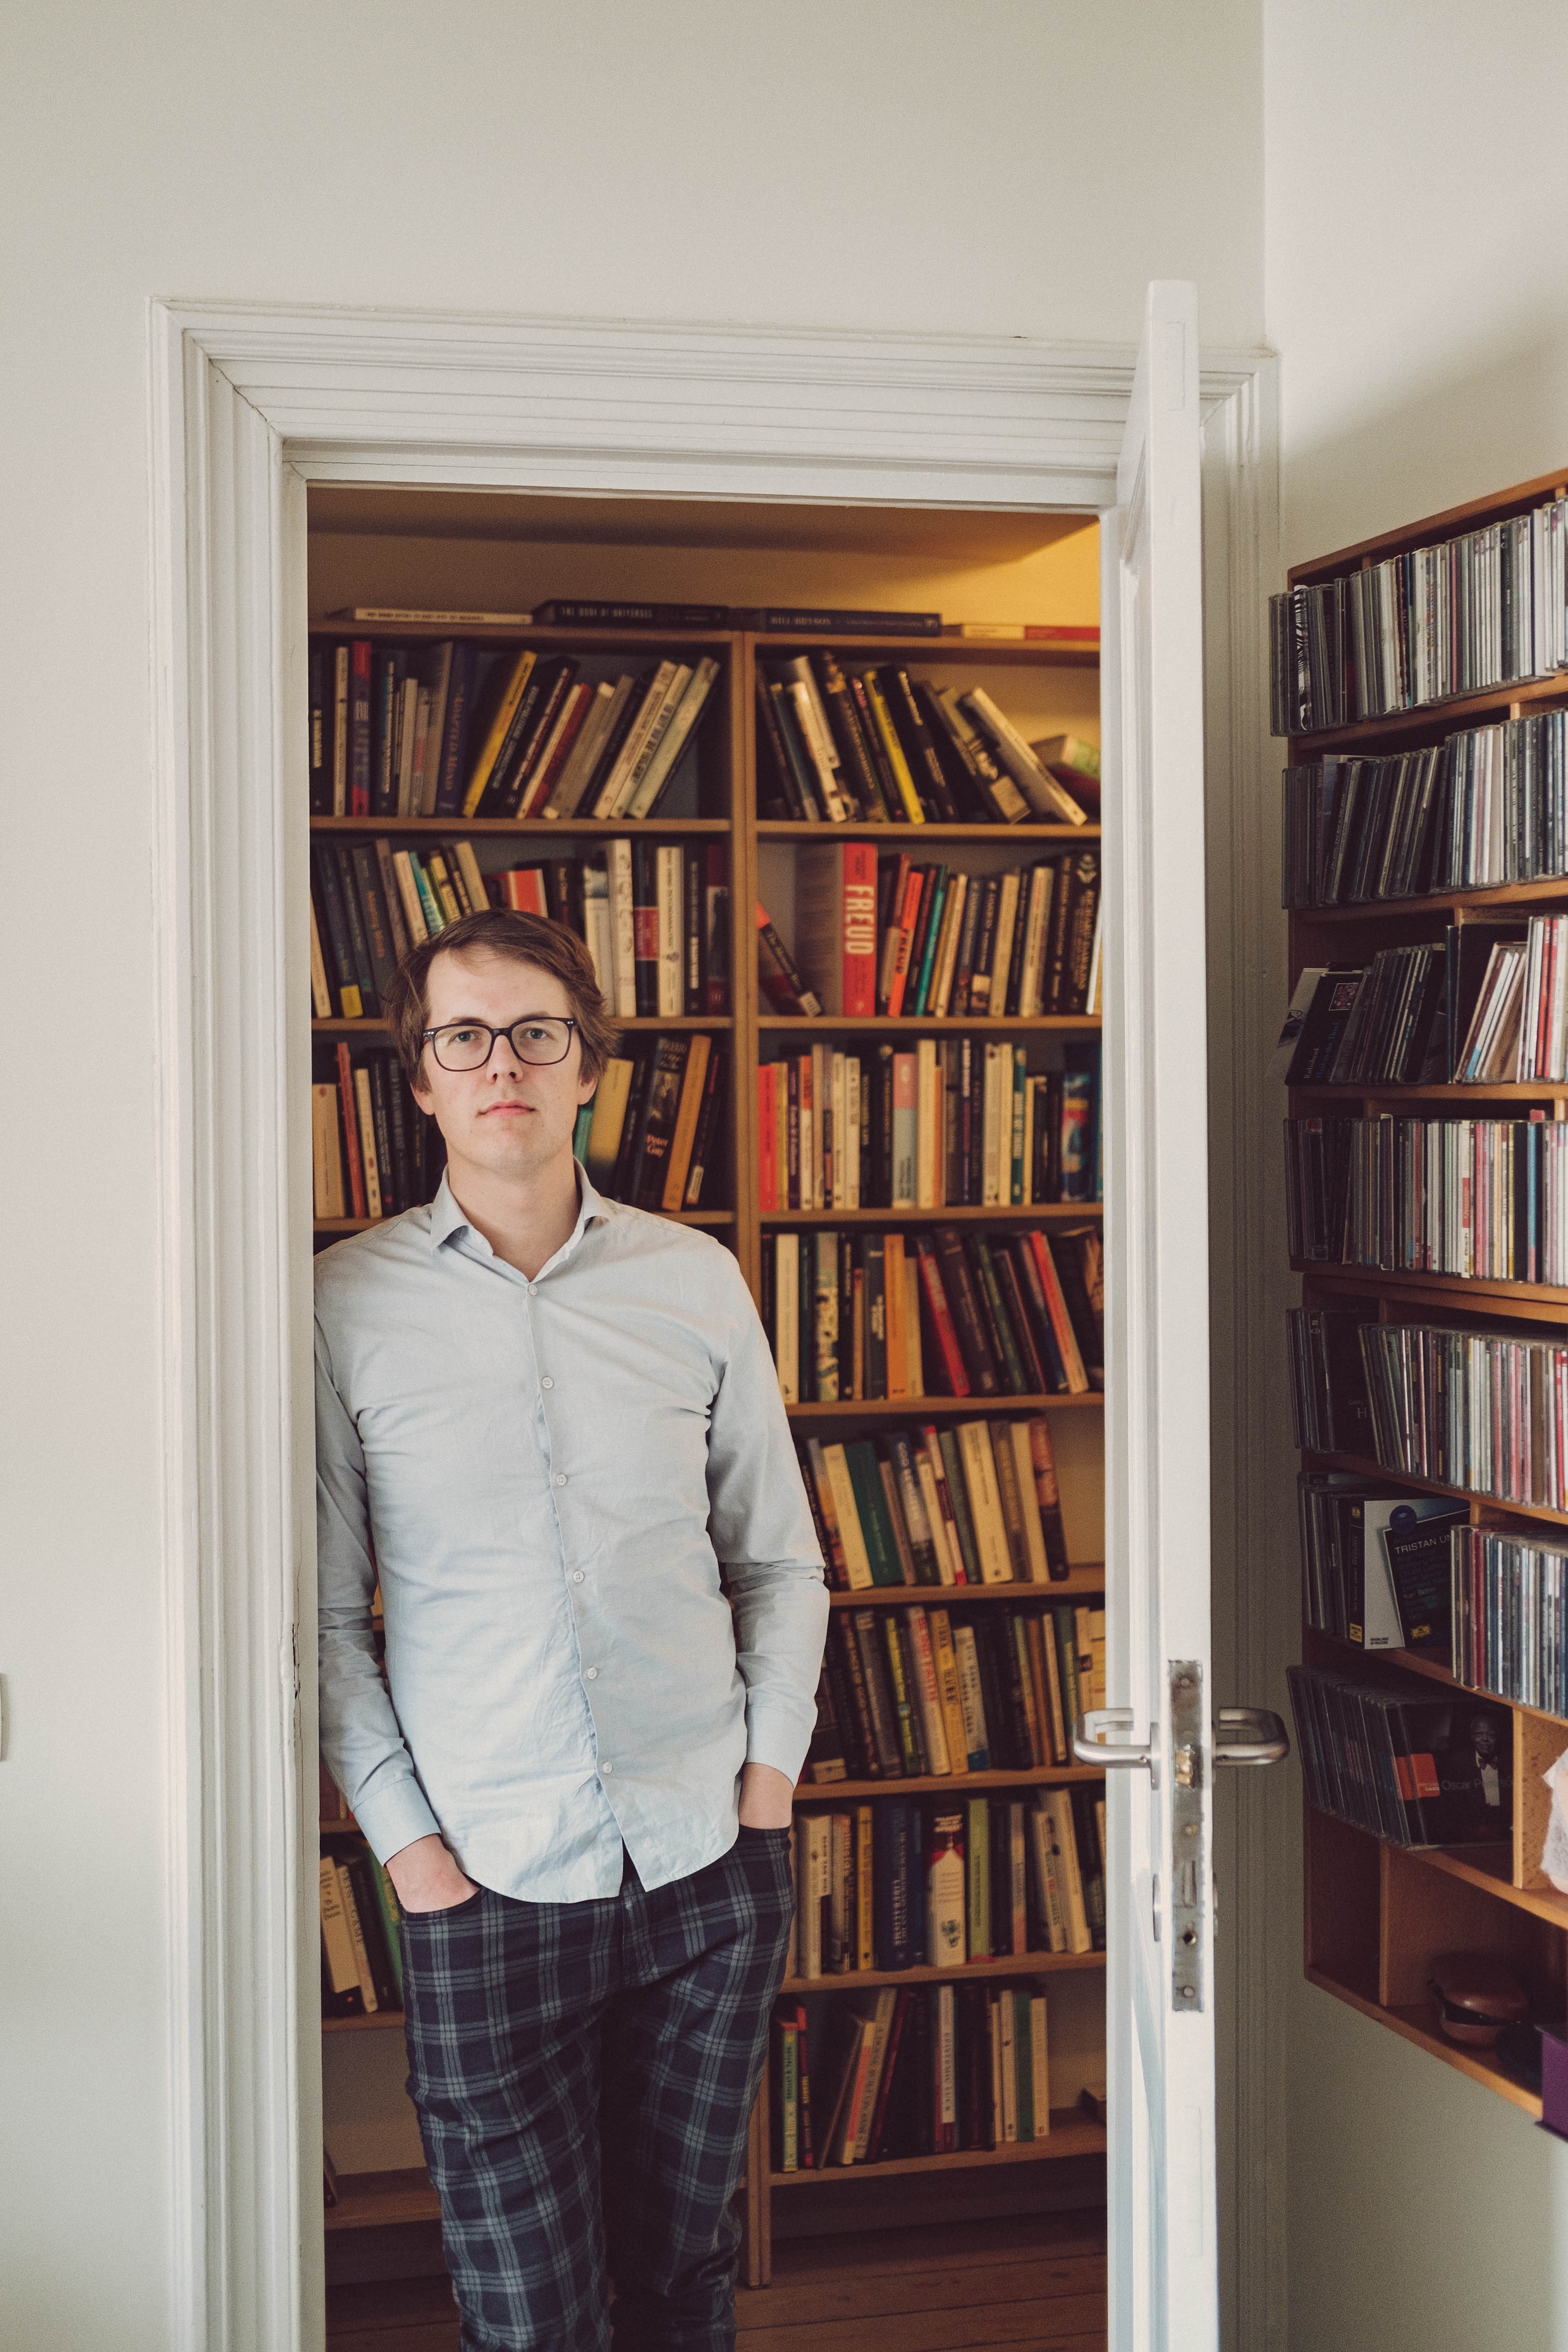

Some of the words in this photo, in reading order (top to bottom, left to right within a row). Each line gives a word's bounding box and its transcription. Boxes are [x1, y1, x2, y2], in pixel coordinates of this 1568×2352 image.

[845, 885, 876, 955] FREUD
[1304, 1047, 1320, 1080] Radiohead
[897, 1441, 910, 1467] GOD
[1395, 1538, 1436, 1555] TRISTAN
[1439, 1534, 1450, 1543] UN
[915, 1616, 931, 1658] BLIND
[922, 1660, 938, 1702] FAITH
[1442, 1780, 1471, 1791] Oscar
